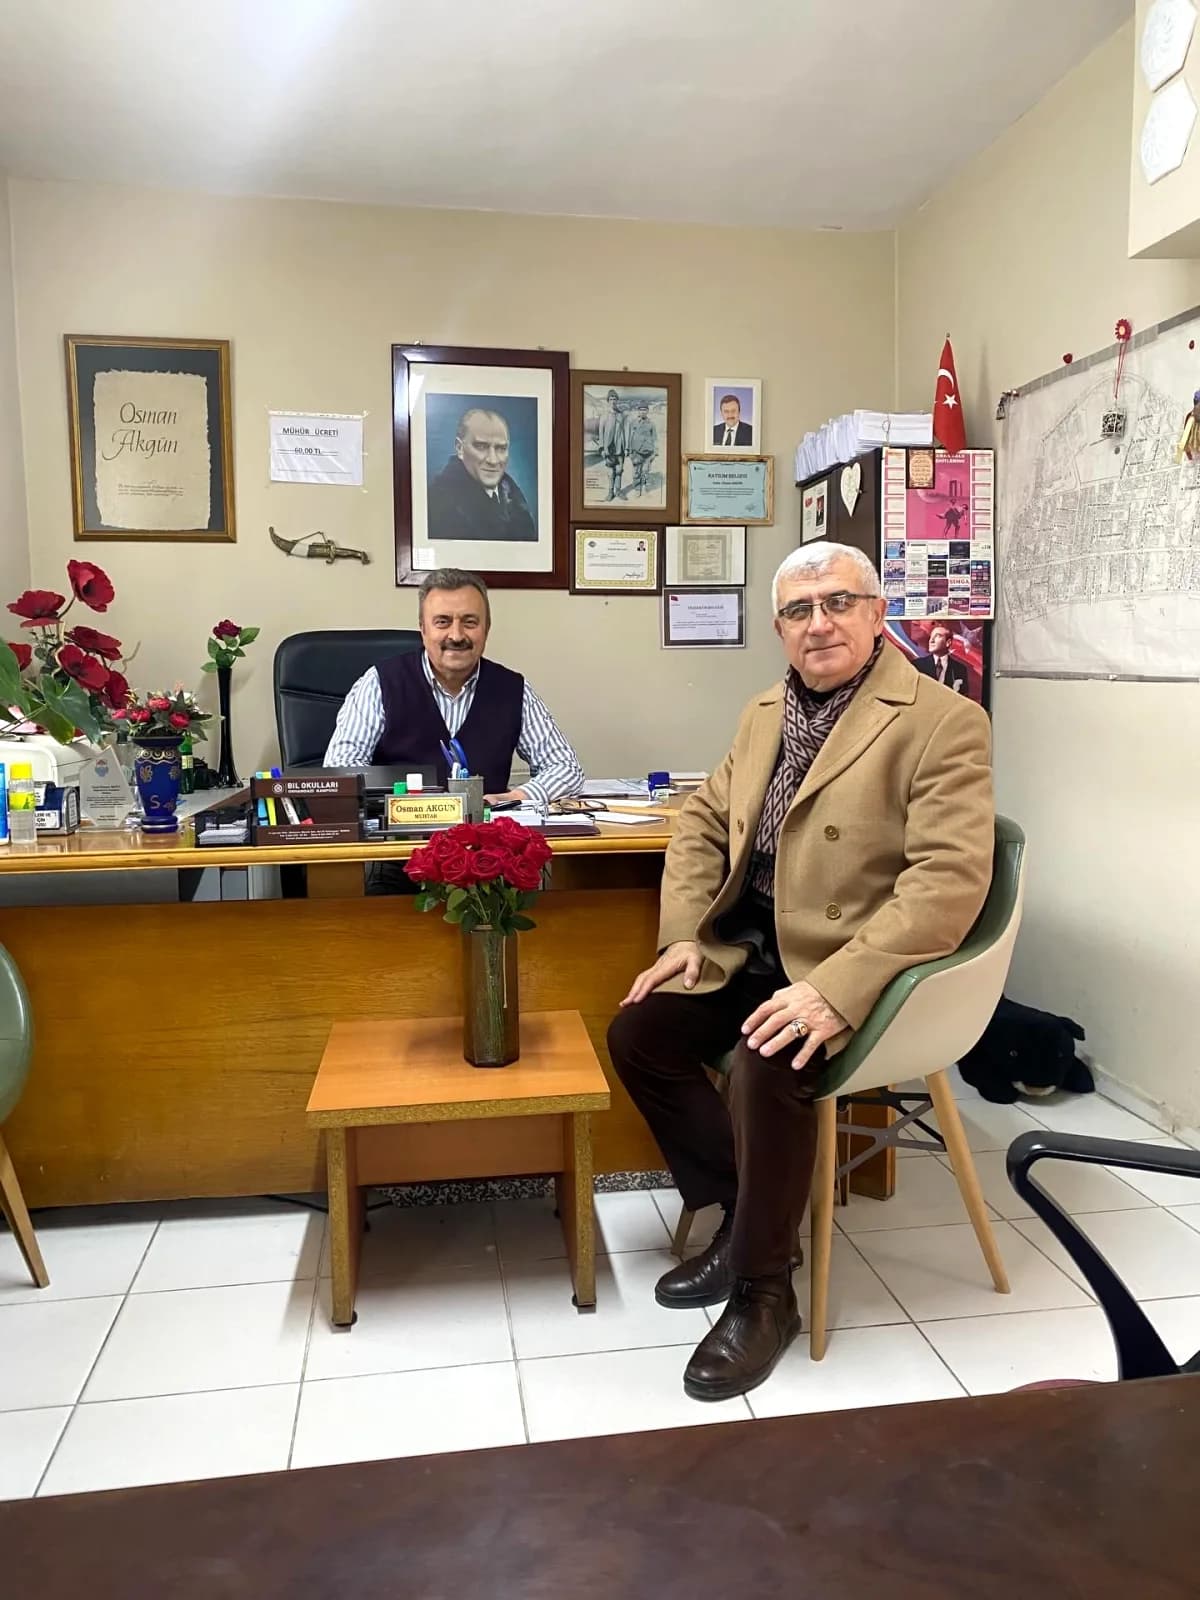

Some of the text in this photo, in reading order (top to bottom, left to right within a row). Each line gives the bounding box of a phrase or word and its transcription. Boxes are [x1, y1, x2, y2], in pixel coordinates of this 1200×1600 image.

[120, 402, 177, 424] Osman
[282, 427, 310, 435] MÜHÜR
[102, 428, 178, 460] Akgün
[301, 781, 339, 789] OKULLARI
[395, 805, 424, 813] Osman
